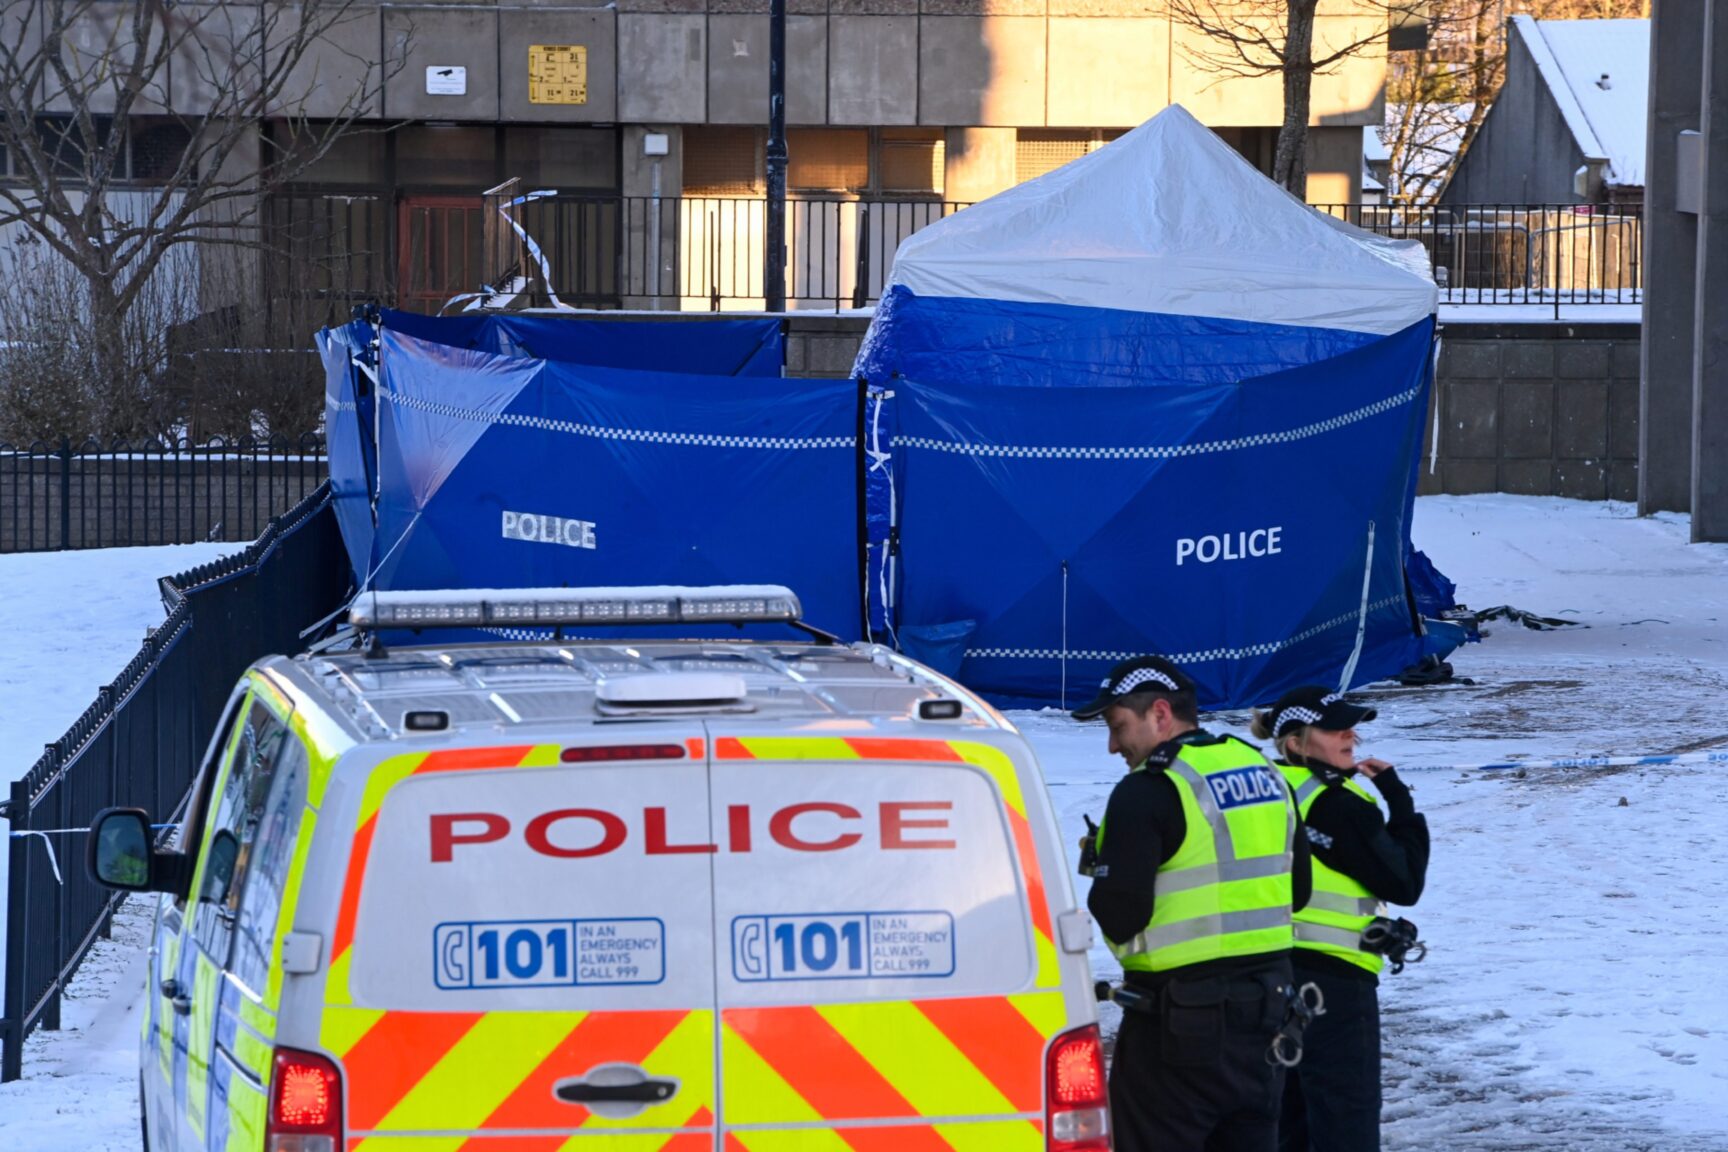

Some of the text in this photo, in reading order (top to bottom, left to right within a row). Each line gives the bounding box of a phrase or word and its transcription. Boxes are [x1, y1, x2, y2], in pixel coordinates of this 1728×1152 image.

[502, 510, 596, 549] POLICE
[1176, 526, 1282, 566] POLICE
[1210, 768, 1282, 804] POLICE
[430, 801, 956, 862] POLICE
[873, 919, 908, 930] IN AN
[580, 926, 616, 937] IN AN
[873, 931, 948, 944] EMERGENCY
[580, 938, 658, 951] EMERGENCY
[774, 921, 863, 972] 101
[477, 928, 567, 979] 101
[873, 945, 923, 958] ALWAYS
[580, 953, 631, 965] ALWAYS
[874, 958, 930, 971] CALL 999
[580, 966, 639, 979] CALL 999
